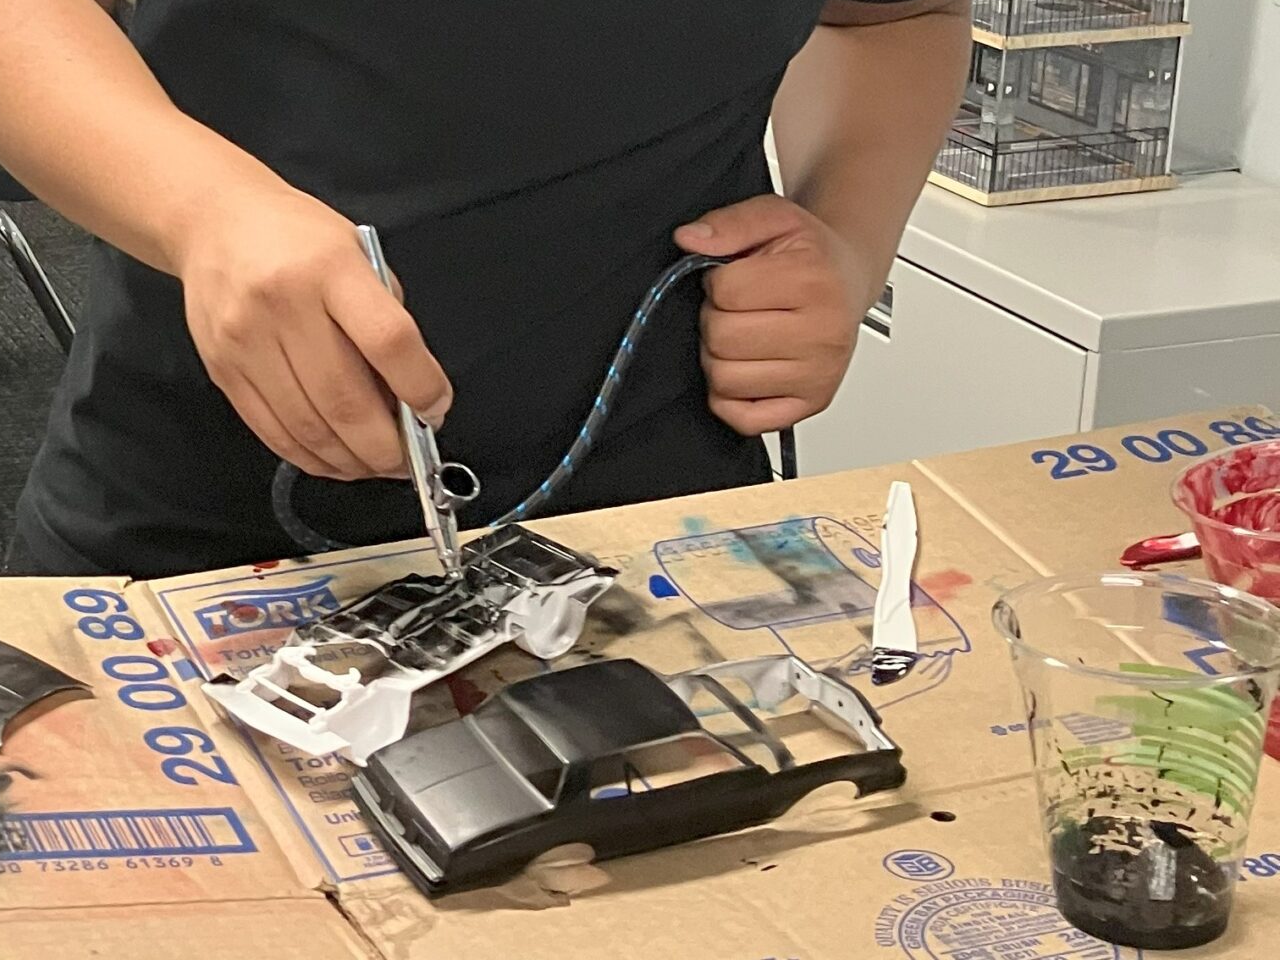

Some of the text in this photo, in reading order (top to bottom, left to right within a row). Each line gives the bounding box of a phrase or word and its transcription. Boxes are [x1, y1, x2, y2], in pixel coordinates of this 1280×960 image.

[1031, 444, 1118, 480] 29
[1120, 429, 1209, 463] 00
[220, 644, 276, 661] Tork
[63, 588, 240, 786] 29 00 89
[297, 772, 349, 788] Rollo
[36, 859, 110, 872] 73286
[125, 857, 195, 870] 61369
[210, 855, 223, 866] 8
[943, 890, 1051, 904] PACKAGING
[875, 904, 904, 947] QUALITY
[892, 894, 916, 906] IS
[912, 877, 992, 898] SERIOUS
